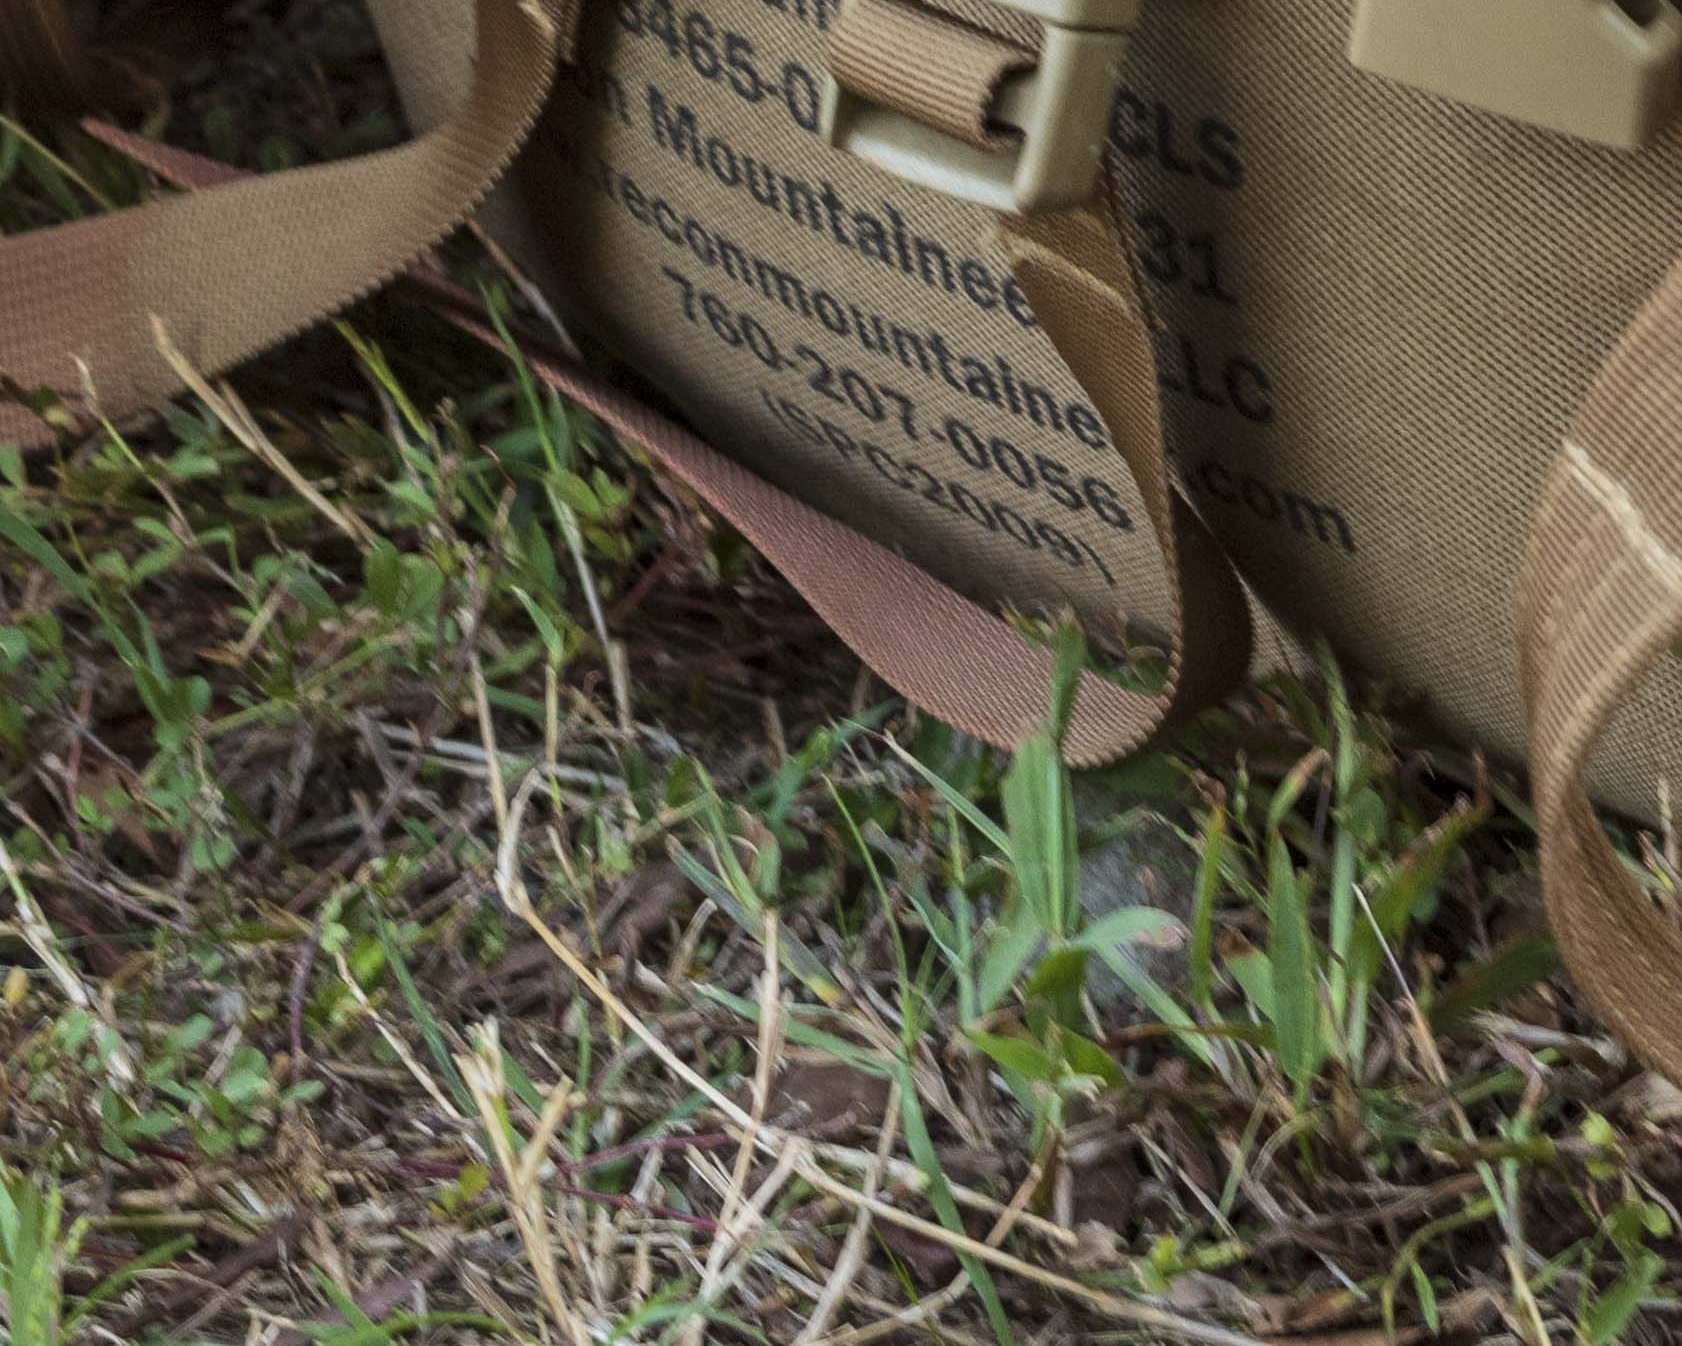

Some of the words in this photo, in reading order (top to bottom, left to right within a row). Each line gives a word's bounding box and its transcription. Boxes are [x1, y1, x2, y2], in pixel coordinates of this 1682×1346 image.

[600, 154, 1108, 452] reconmountaine
[648, 82, 1038, 330] Mountainee
[660, 264, 1134, 532] 760-207-0056
